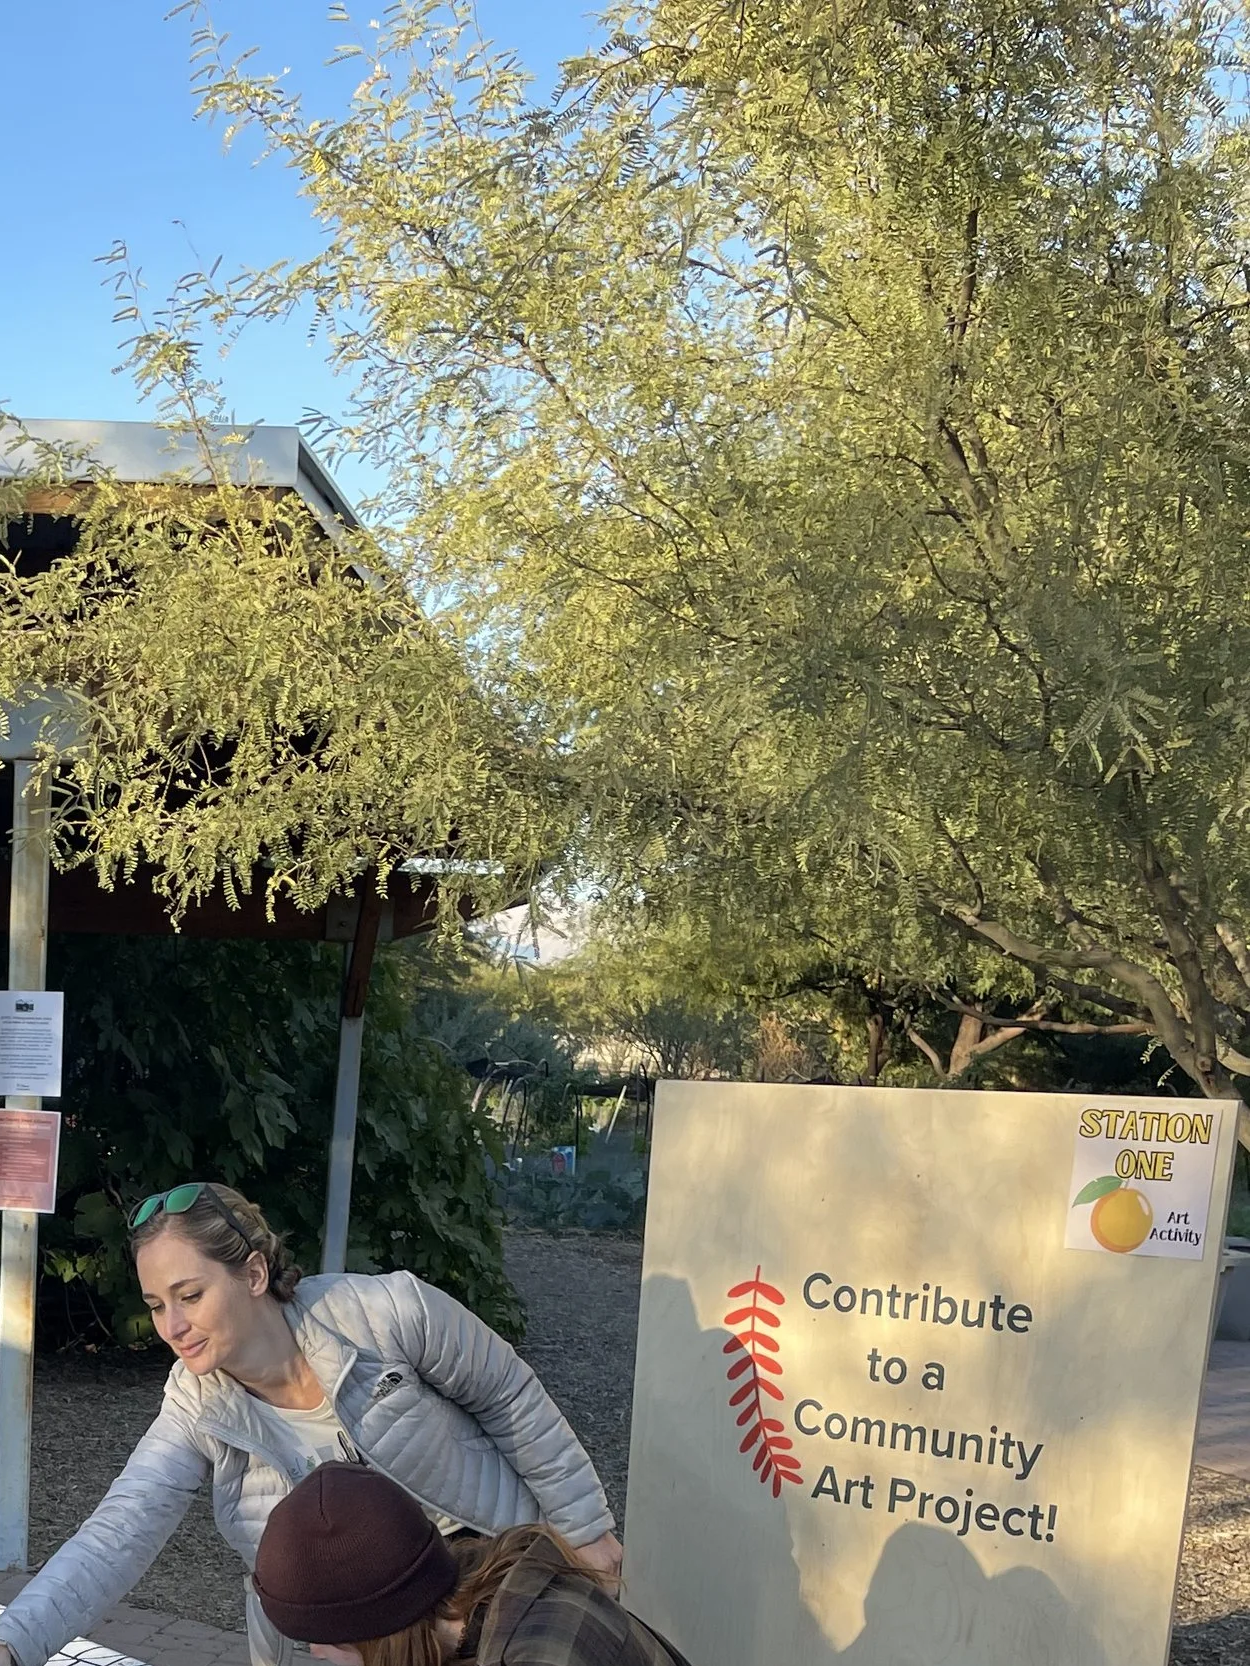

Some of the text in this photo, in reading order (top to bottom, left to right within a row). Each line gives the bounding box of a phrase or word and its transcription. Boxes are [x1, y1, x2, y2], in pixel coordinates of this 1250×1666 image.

[1079, 1108, 1213, 1144] STATION
[1115, 1149, 1174, 1181] ONE
[1150, 1227, 1202, 1246] Activity
[1167, 1211, 1190, 1224] Art
[802, 1272, 1033, 1333] Contribute
[867, 1348, 946, 1391] to a
[793, 1399, 1044, 1480] Community
[810, 1466, 1058, 1543] Art Project!
